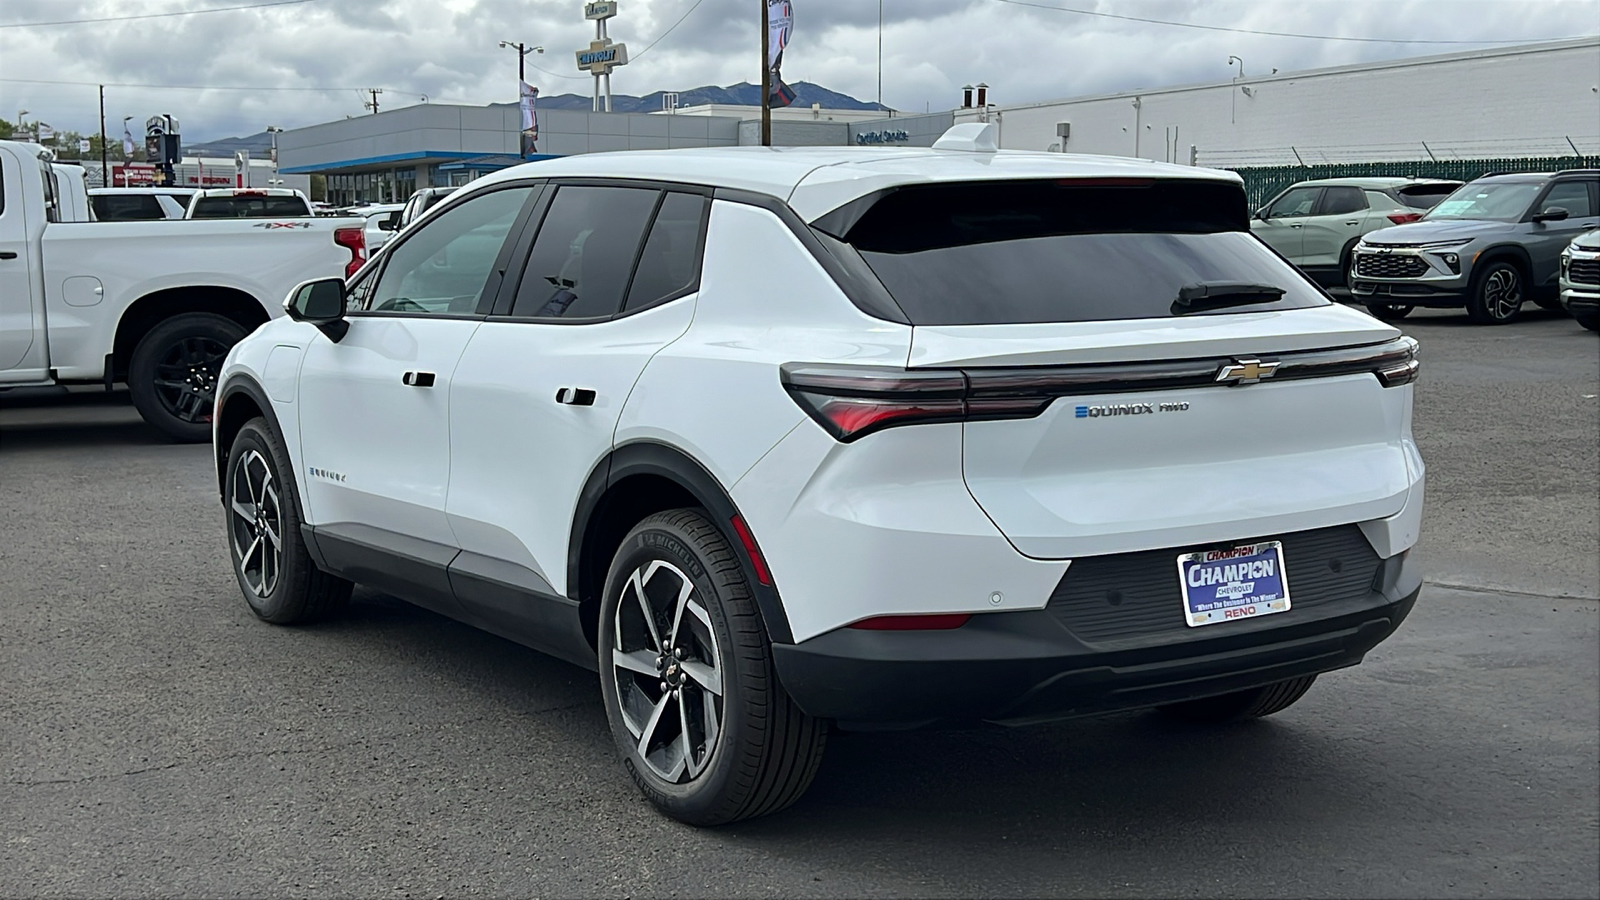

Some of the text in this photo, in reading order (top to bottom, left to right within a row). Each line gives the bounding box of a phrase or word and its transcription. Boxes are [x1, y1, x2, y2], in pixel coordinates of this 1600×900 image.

[1075, 402, 1154, 418] EQUINOX
[655, 535, 700, 577] MICHELIN
[1206, 546, 1255, 561] CHAMPION
[1188, 559, 1274, 588] CHAMPION
[1217, 584, 1252, 595] CHEVROLET
[1223, 598, 1246, 608] Customer
[1251, 595, 1260, 603] The
[1224, 606, 1256, 619] RENO
